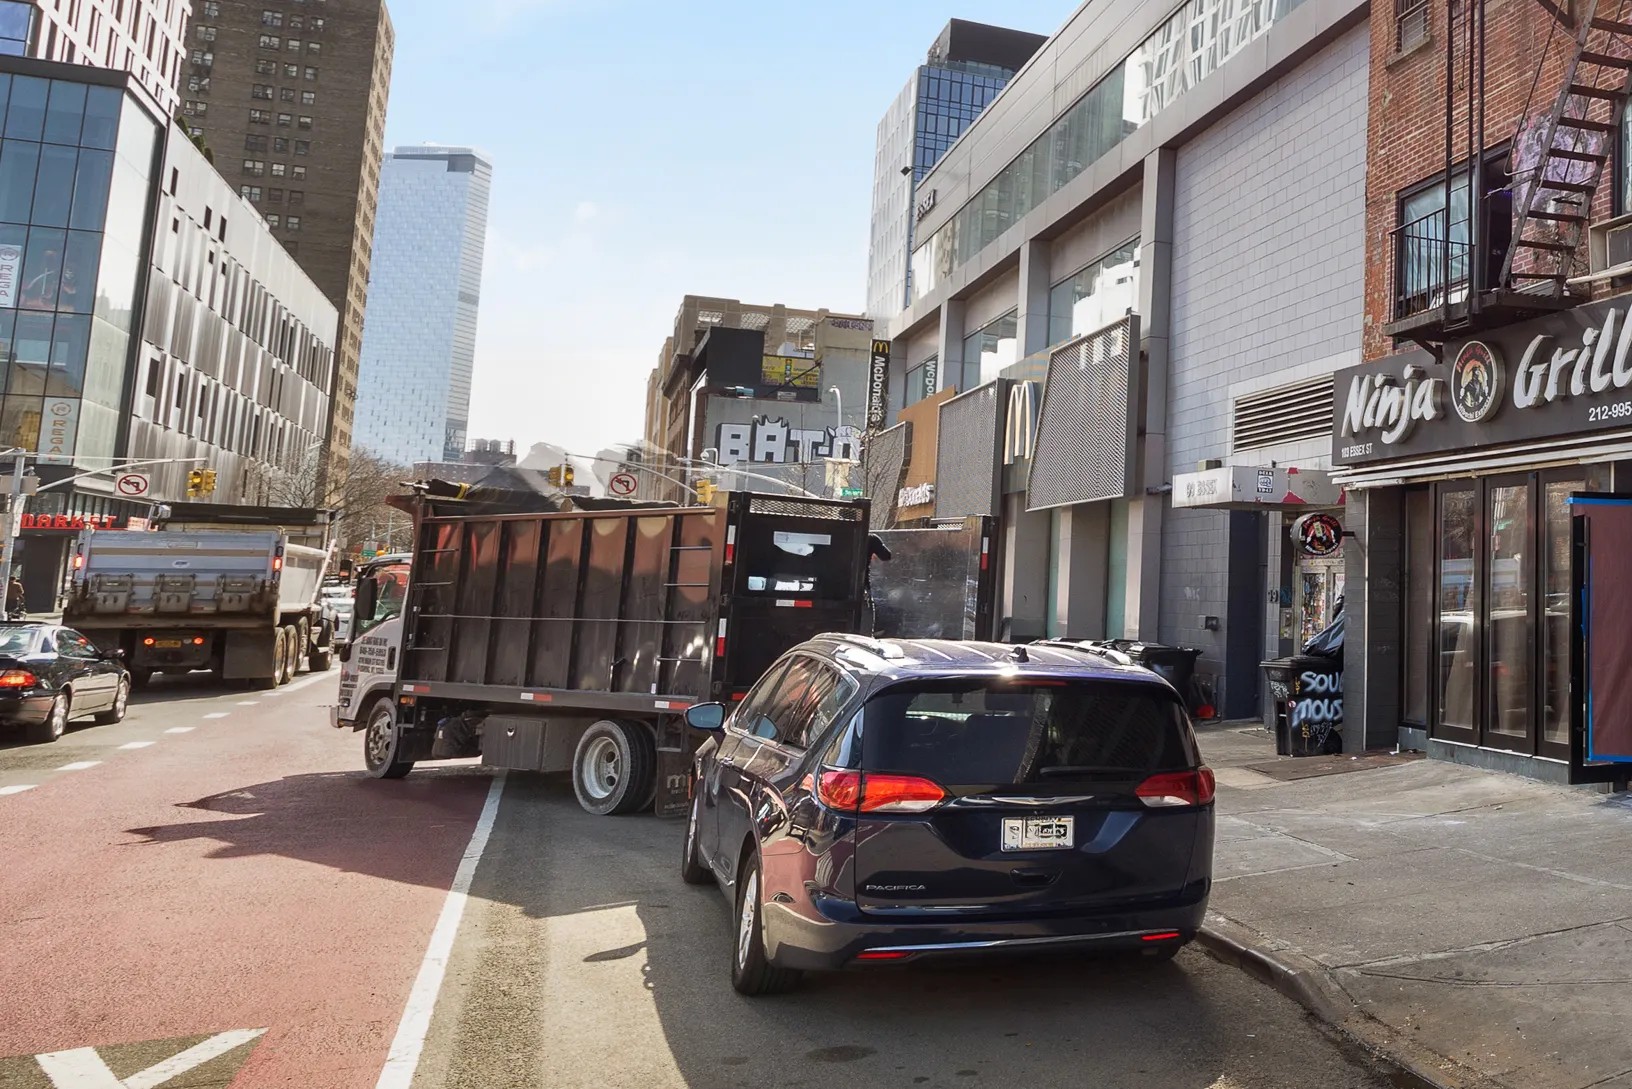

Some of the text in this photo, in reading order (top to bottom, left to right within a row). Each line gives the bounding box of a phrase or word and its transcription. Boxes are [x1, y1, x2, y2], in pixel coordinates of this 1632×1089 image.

[1341, 363, 1445, 445] Ninja
[1350, 443, 1366, 457] ESSEX
[1366, 442, 1373, 454] ST
[22, 513, 117, 528] MARKET
